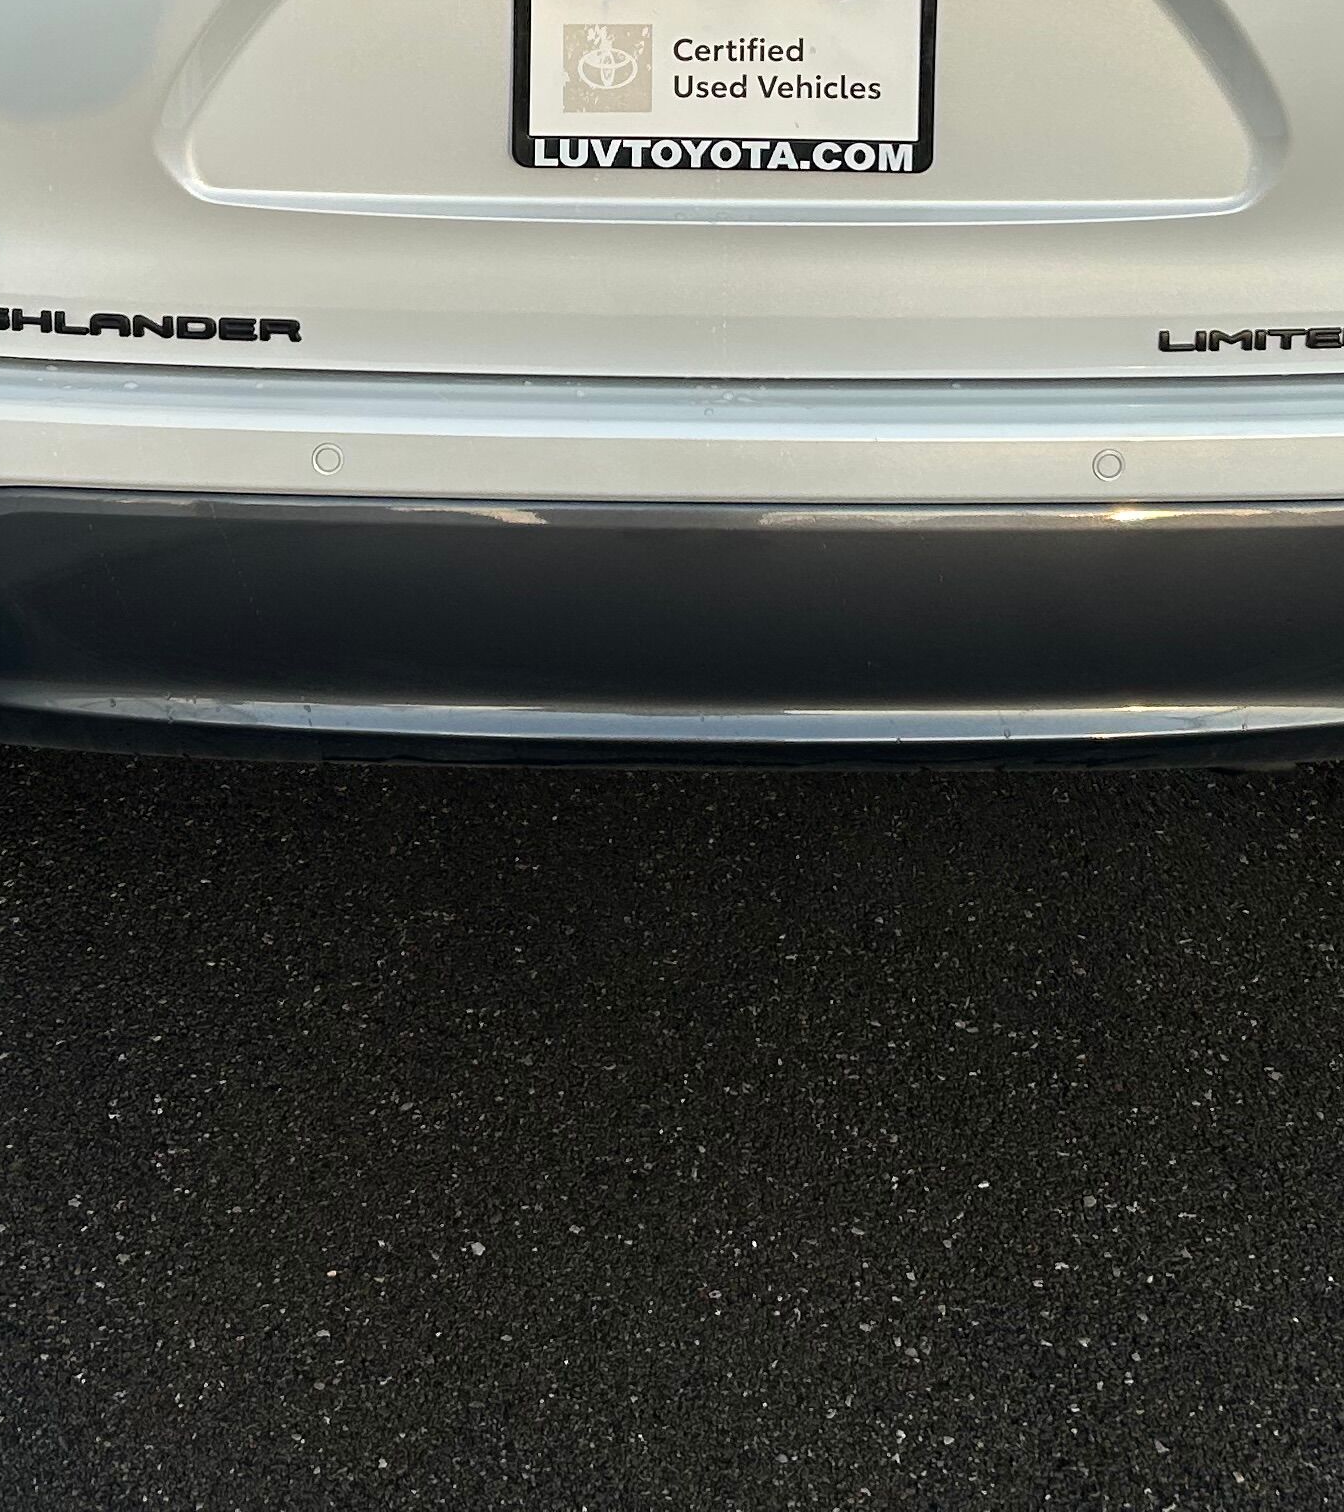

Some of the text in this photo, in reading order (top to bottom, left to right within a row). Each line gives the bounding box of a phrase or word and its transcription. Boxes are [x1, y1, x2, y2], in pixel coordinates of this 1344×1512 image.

[673, 38, 805, 63] Certified
[673, 75, 882, 100] Used Vehicles
[533, 138, 914, 172] LUVTOYOTA.COM
